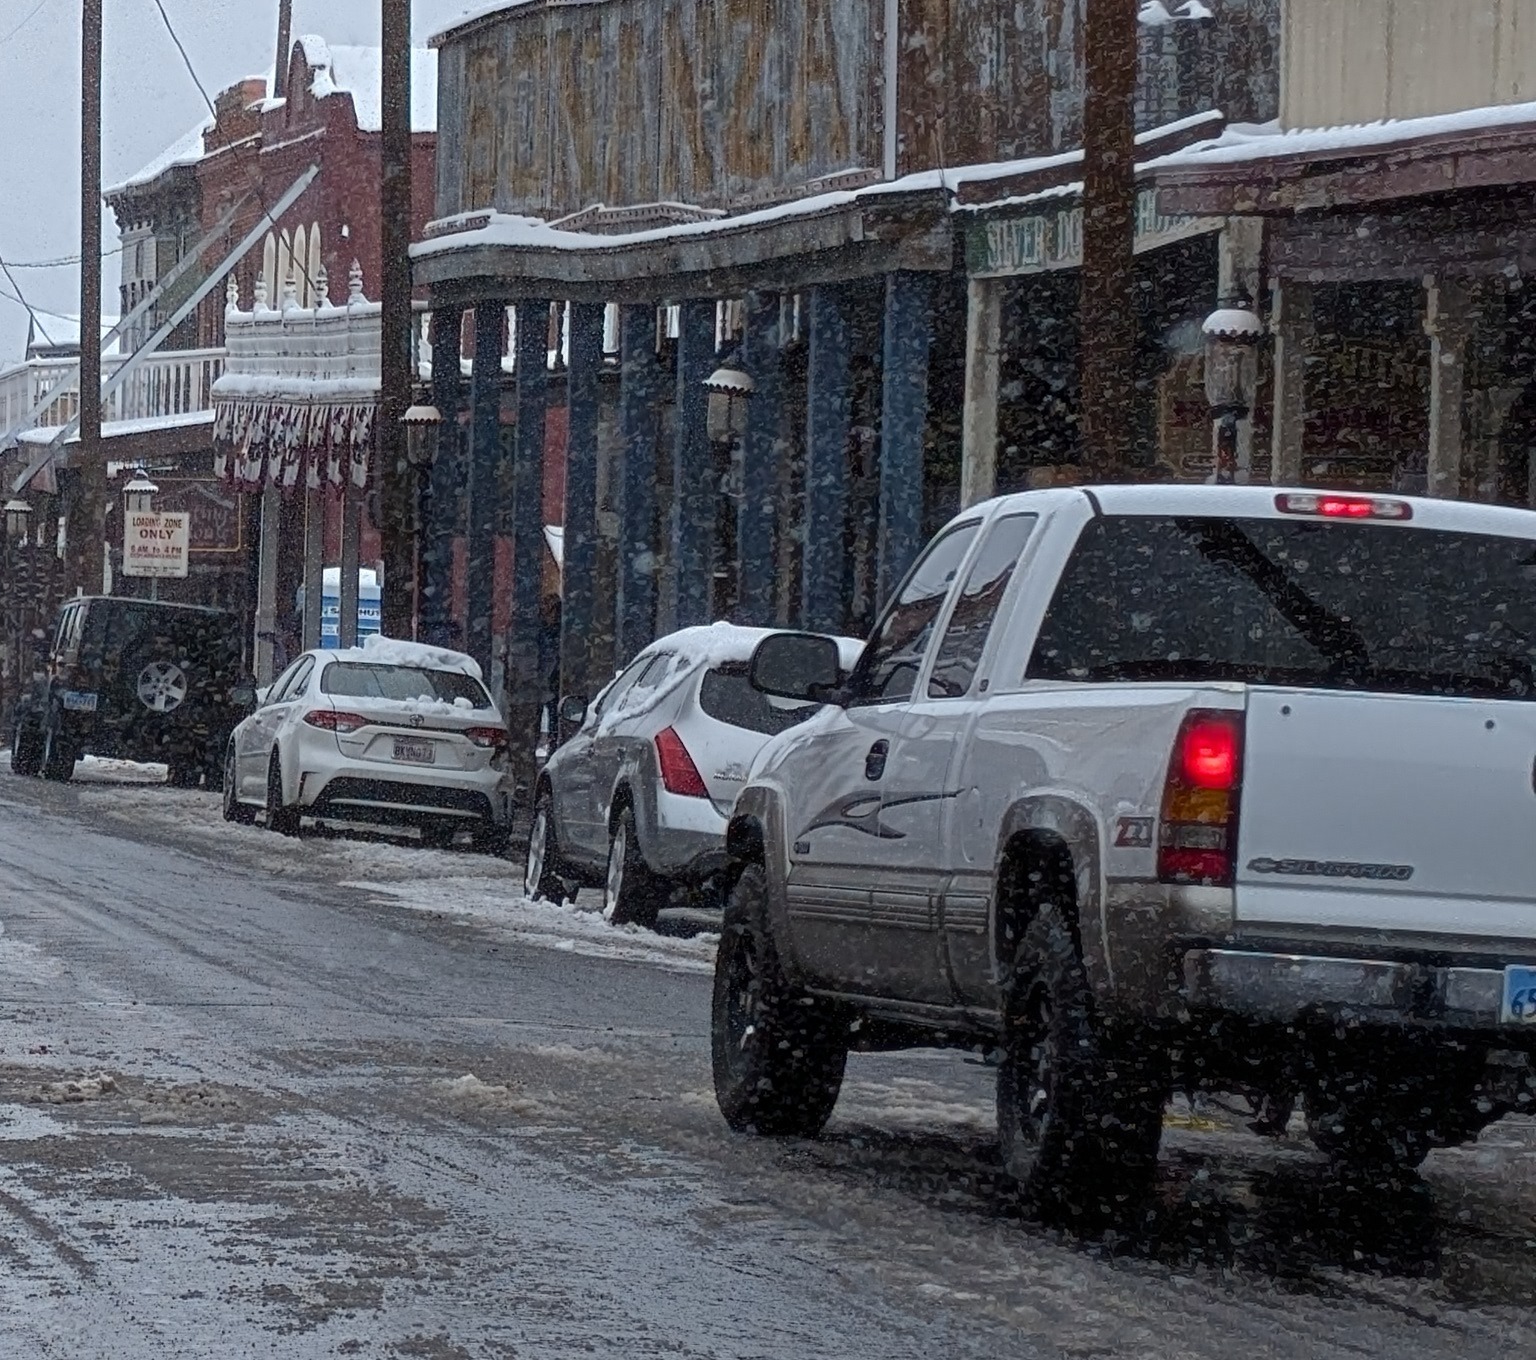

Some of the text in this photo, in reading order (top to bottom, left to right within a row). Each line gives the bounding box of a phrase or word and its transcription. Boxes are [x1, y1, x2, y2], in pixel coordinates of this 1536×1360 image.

[133, 517, 182, 529] LOADING ZONE
[139, 529, 174, 540] ONLY
[1277, 860, 1411, 879] SILVERADO
